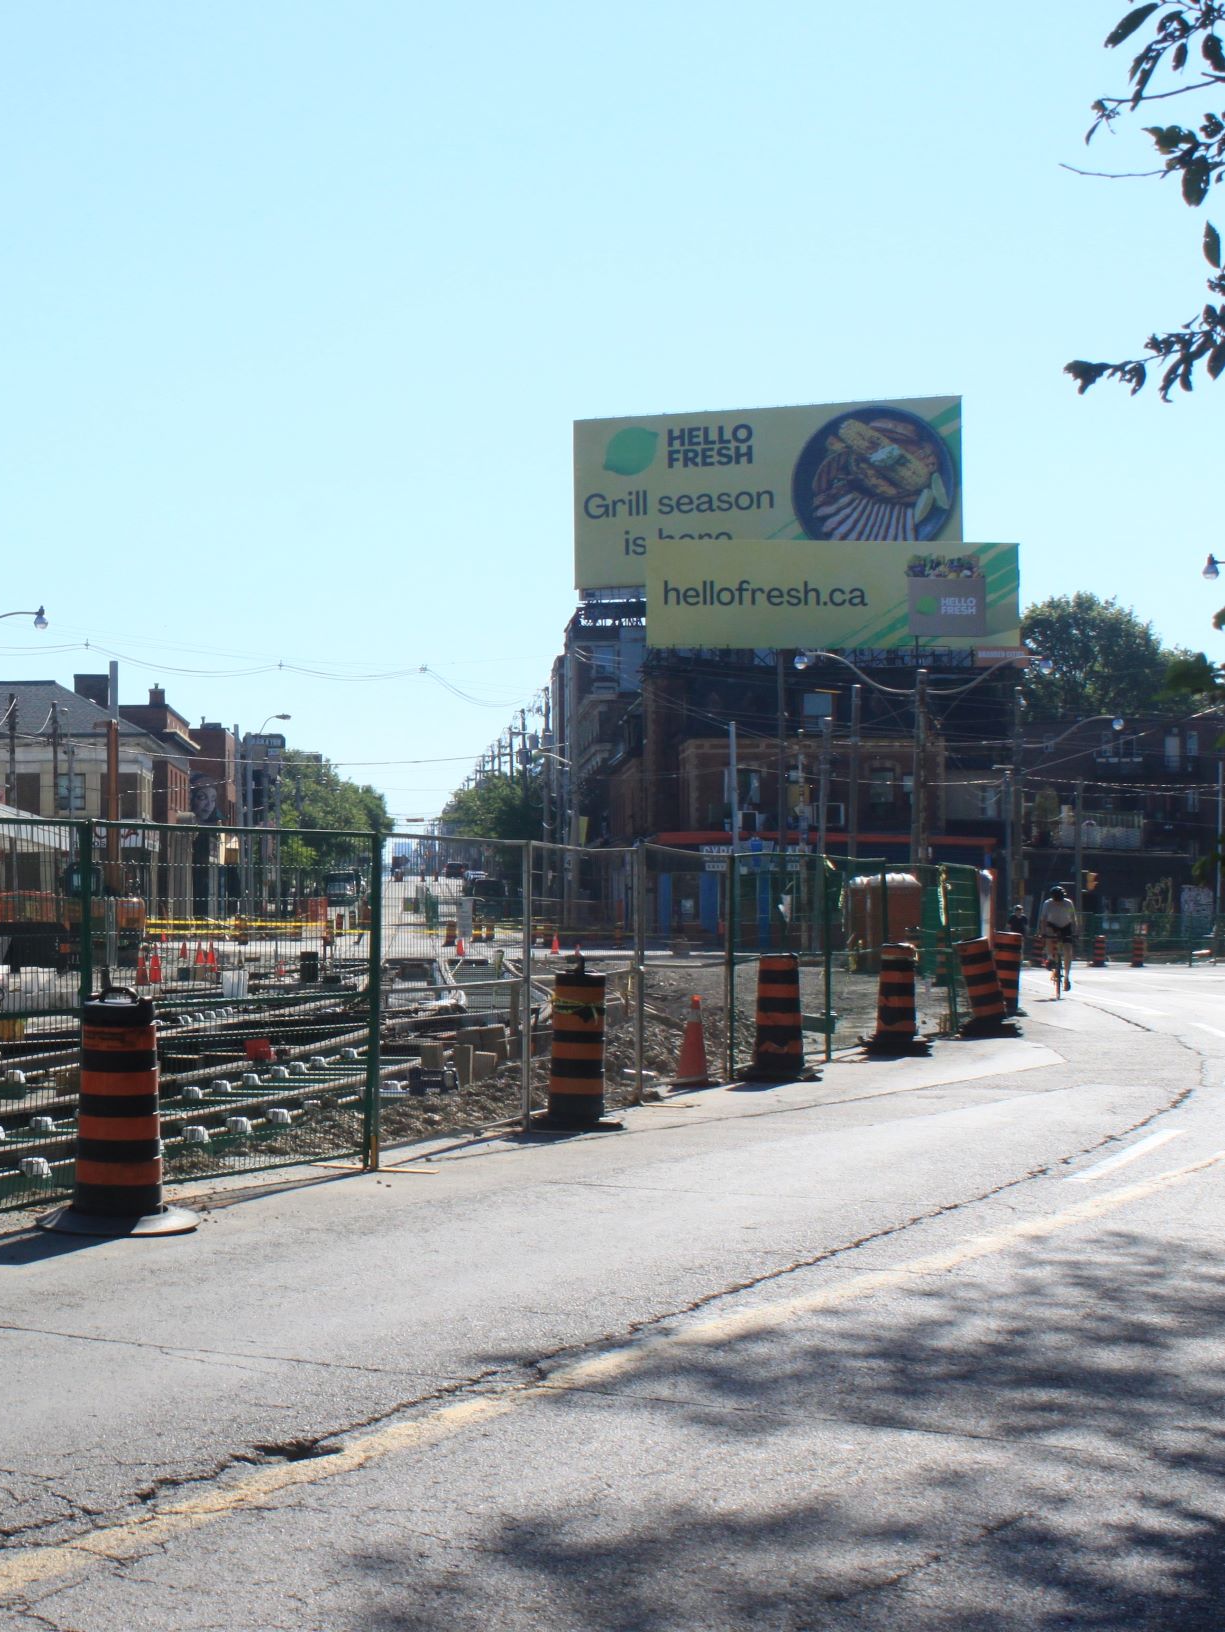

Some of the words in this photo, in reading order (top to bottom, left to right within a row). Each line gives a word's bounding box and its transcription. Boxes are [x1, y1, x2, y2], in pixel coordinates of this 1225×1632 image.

[666, 423, 753, 448] HELLO
[667, 445, 753, 468] FRESH
[583, 489, 647, 519] Grill
[657, 489, 774, 515] season
[624, 530, 647, 556] is
[663, 579, 868, 607] hellofresh.ca
[940, 597, 976, 606] HELLO
[940, 606, 976, 615] FRESH
